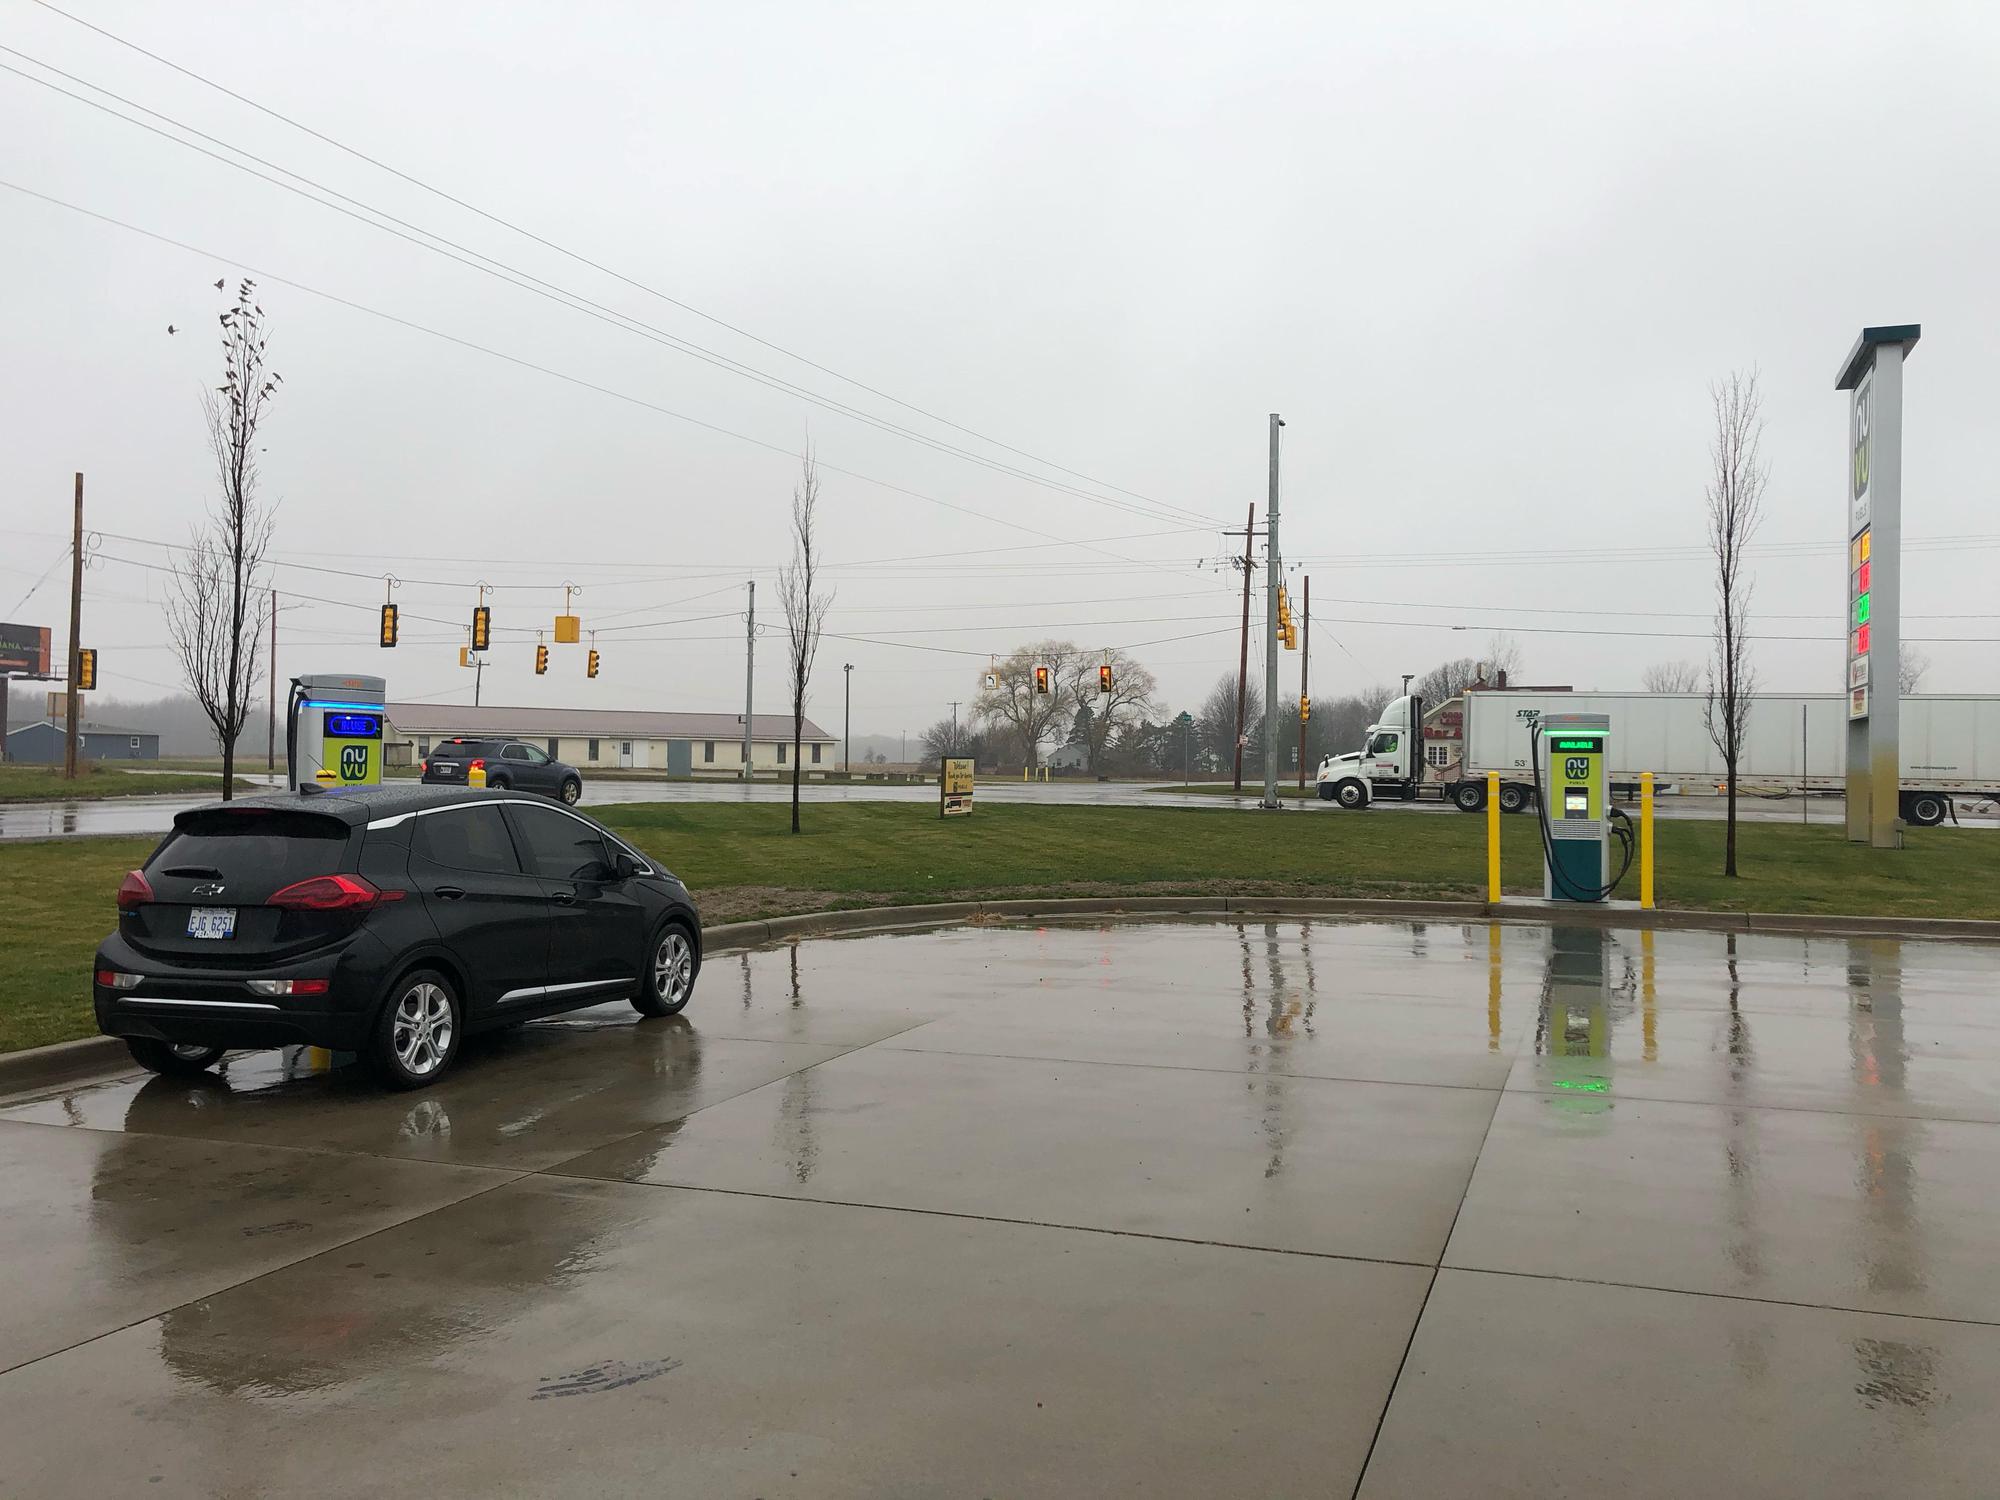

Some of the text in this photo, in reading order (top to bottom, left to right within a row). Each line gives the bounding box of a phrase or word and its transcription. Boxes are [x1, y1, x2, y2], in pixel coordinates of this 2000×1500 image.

[1516, 710, 1540, 718] STAR
[351, 721, 367, 732] USE
[190, 916, 233, 932] EJG 6251
[194, 930, 224, 940] FELDMAN
